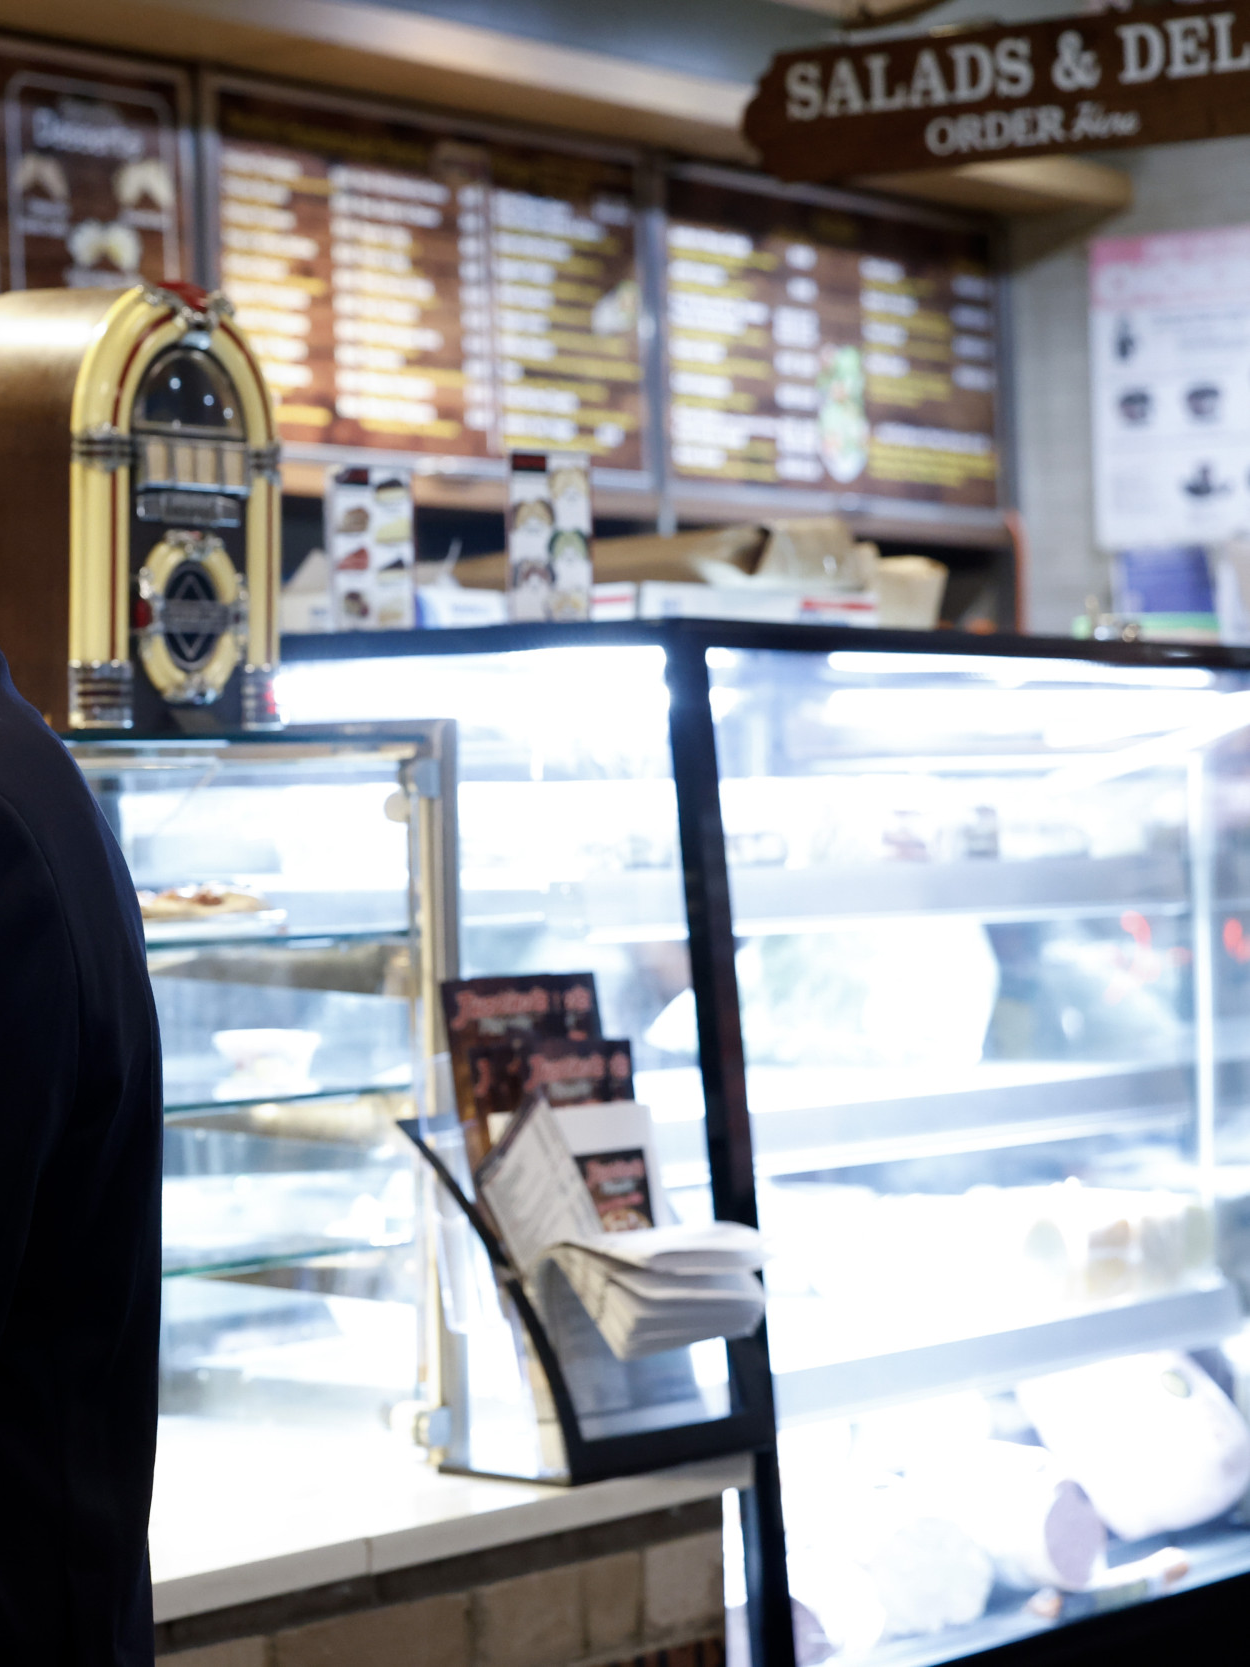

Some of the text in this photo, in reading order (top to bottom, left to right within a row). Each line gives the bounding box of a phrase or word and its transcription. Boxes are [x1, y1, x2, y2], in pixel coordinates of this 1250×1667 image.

[784, 36, 1034, 122] SALADS
[1052, 29, 1103, 92] &
[924, 104, 1066, 156] ORDER
